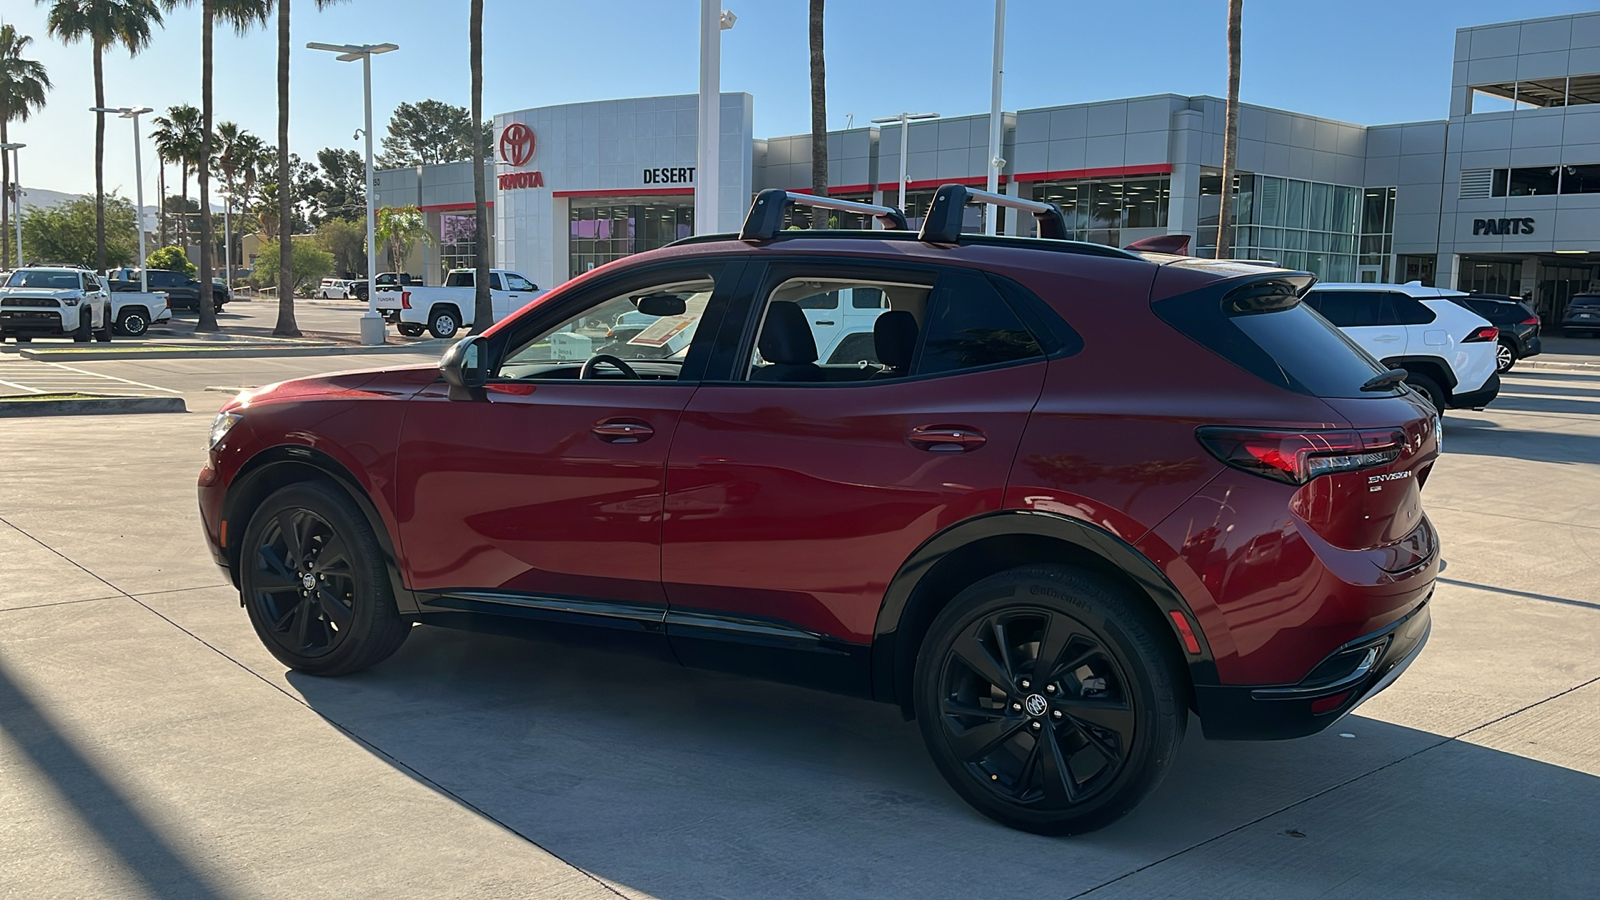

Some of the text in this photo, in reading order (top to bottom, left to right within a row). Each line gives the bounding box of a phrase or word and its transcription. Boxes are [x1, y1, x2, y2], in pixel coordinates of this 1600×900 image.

[497, 171, 544, 190] TOYOTA
[643, 167, 696, 184] DESERT
[1472, 217, 1535, 236] PARTS
